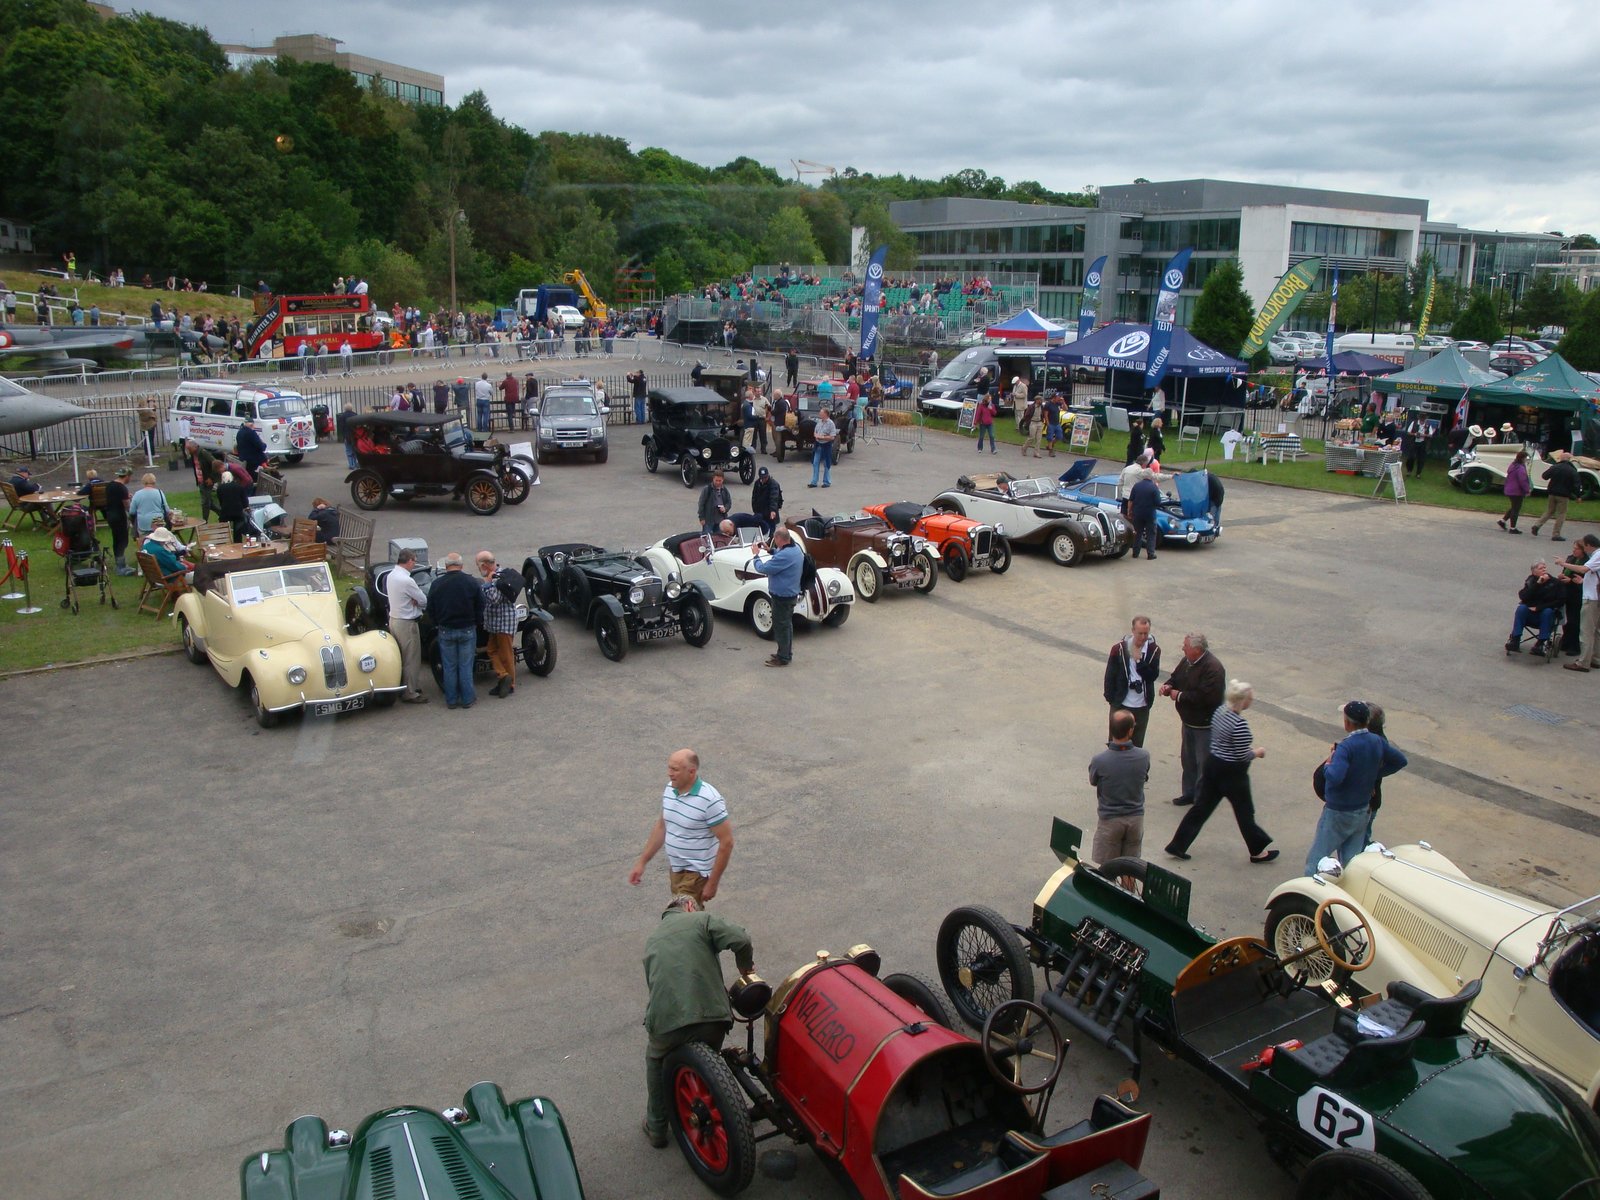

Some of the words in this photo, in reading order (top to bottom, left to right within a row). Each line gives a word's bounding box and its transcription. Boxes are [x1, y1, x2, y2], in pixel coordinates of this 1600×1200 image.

[1082, 355, 1090, 365] THE
[1091, 356, 1109, 367] VINTAGE
[1135, 361, 1147, 371] CLUB
[1396, 382, 1438, 393] BROOKLANDS
[639, 631, 650, 641] MV
[652, 628, 675, 638] 3079
[320, 703, 343, 714] SMG
[345, 699, 359, 710] 72
[791, 984, 856, 1065] NAZZARO
[1313, 1092, 1365, 1149] 62
